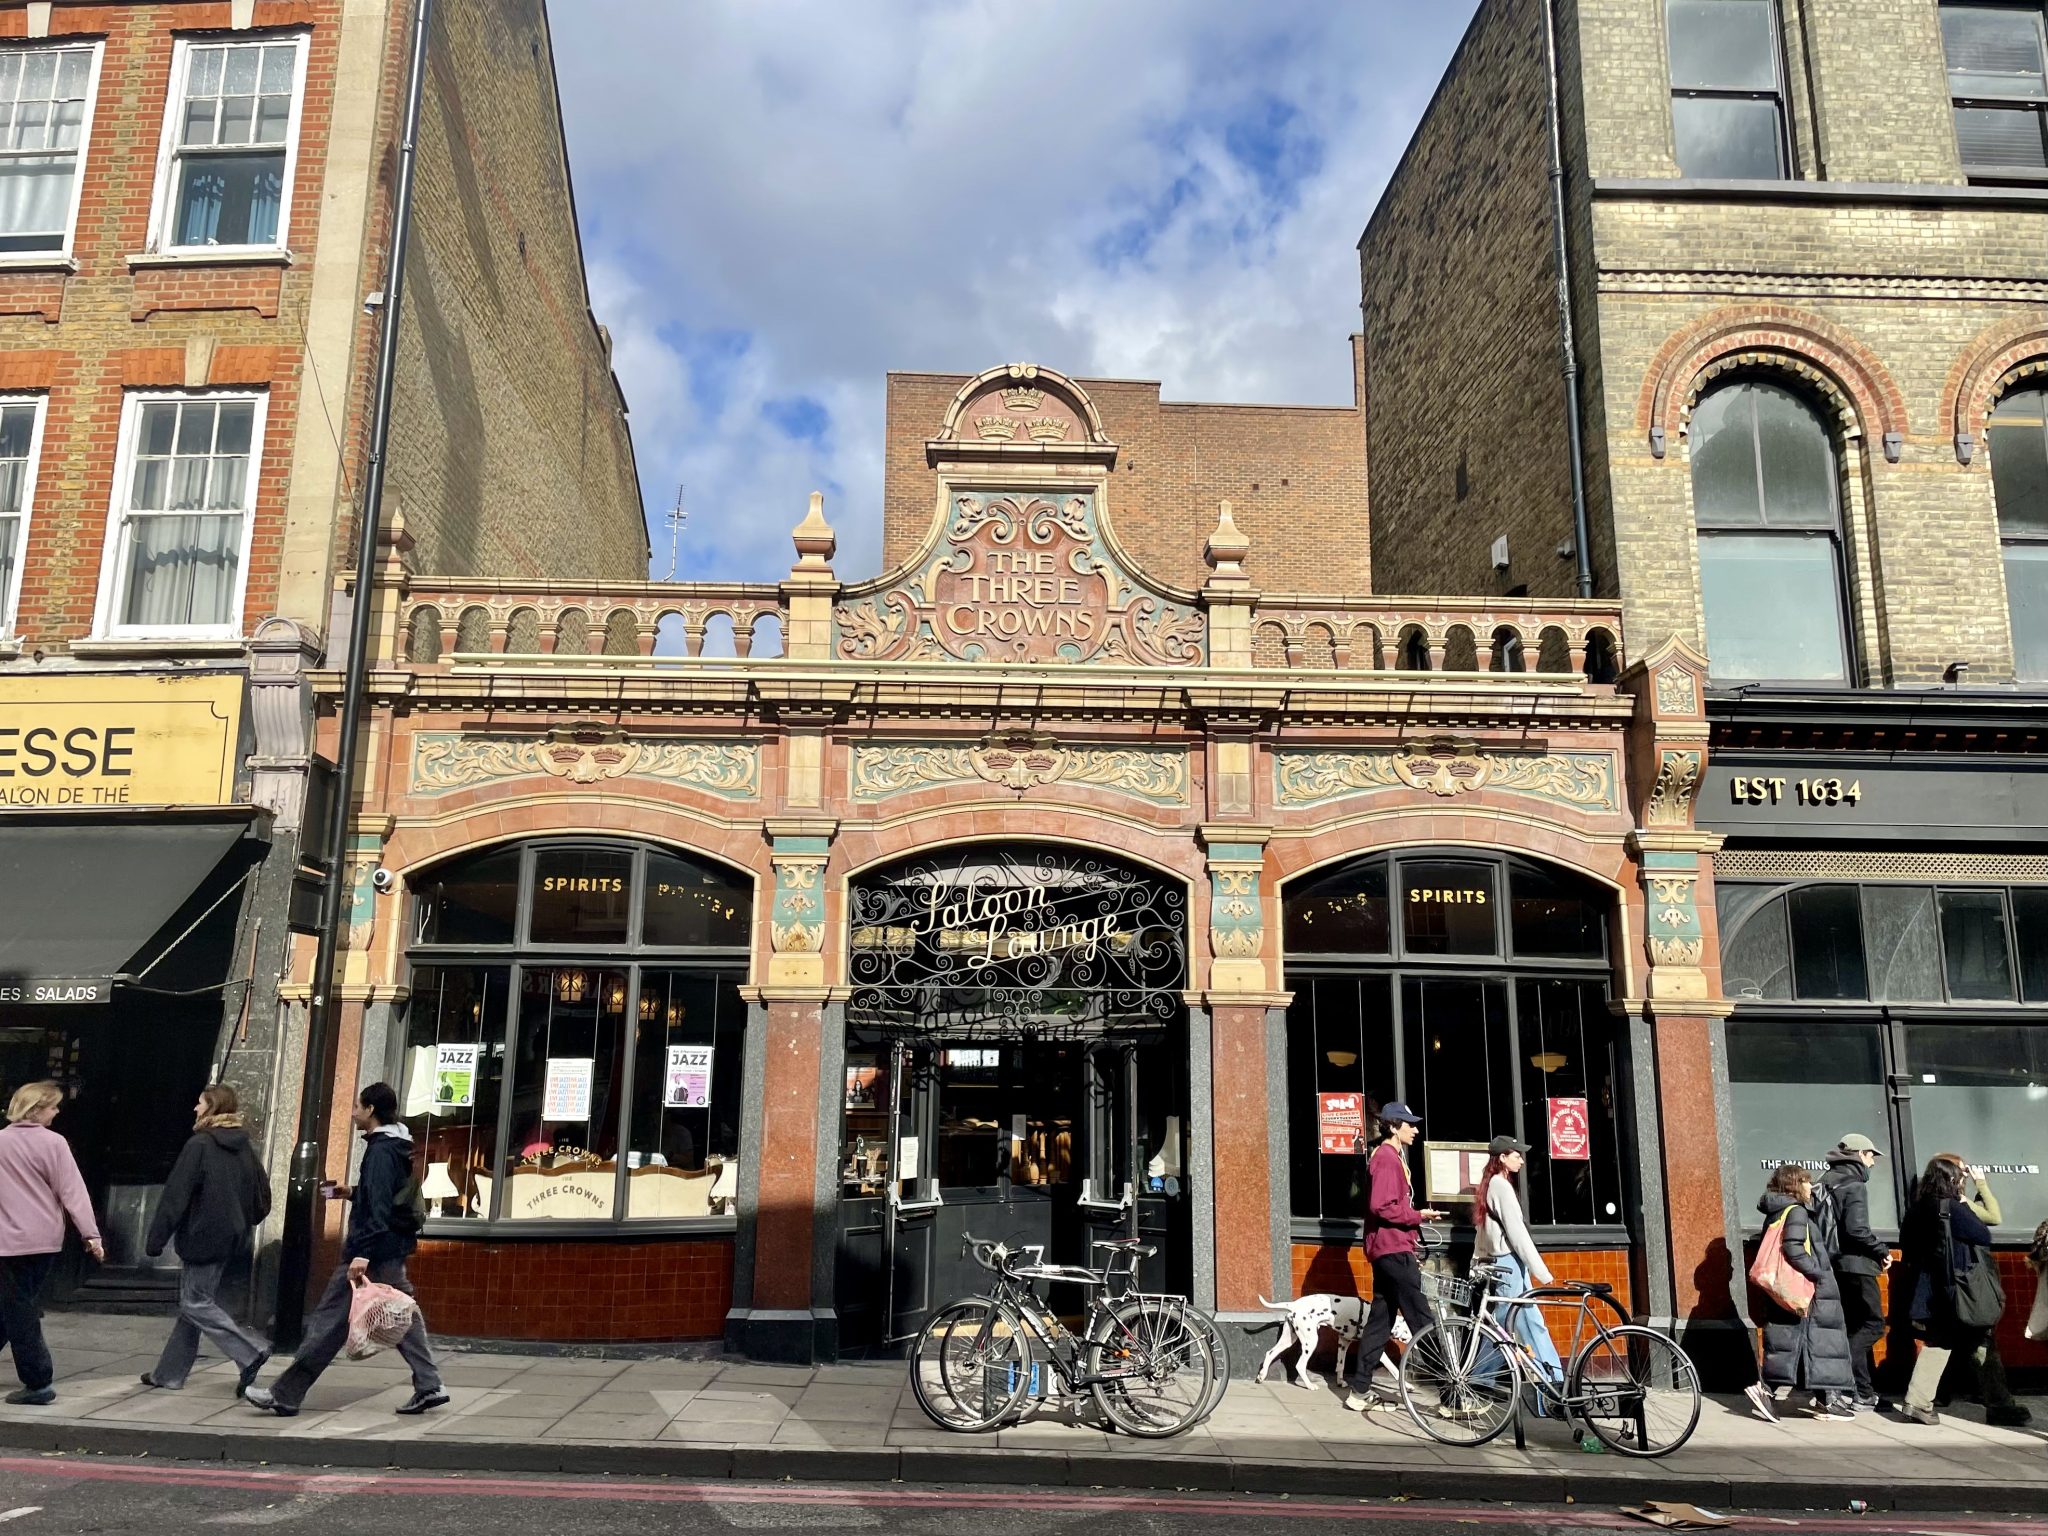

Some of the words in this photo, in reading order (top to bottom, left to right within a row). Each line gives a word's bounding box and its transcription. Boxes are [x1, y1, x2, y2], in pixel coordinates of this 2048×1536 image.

[987, 552, 1056, 574] THE
[960, 575, 1084, 609] THREE
[946, 604, 1095, 642] CROWNS
[57, 787, 84, 803] DE
[92, 784, 129, 803] THÉ
[1733, 777, 1787, 800] EST
[1799, 778, 1862, 801] 1634
[543, 877, 622, 892] SPIRITS
[1410, 888, 1486, 904] SPIRITS
[910, 880, 1050, 935] Saloon
[967, 914, 1121, 969] Lounge
[0, 988, 21, 1001] ES
[35, 986, 97, 1001] SALADS
[314, 995, 322, 1006] 2
[440, 1052, 473, 1064] JAZZ
[672, 1054, 708, 1066] JAZZ
[520, 1146, 555, 1166] THREE
[558, 1145, 603, 1166] CROWNS
[1992, 1165, 2014, 1173] TILL
[526, 1186, 558, 1210] THREE
[562, 1185, 605, 1209] CROWNS
